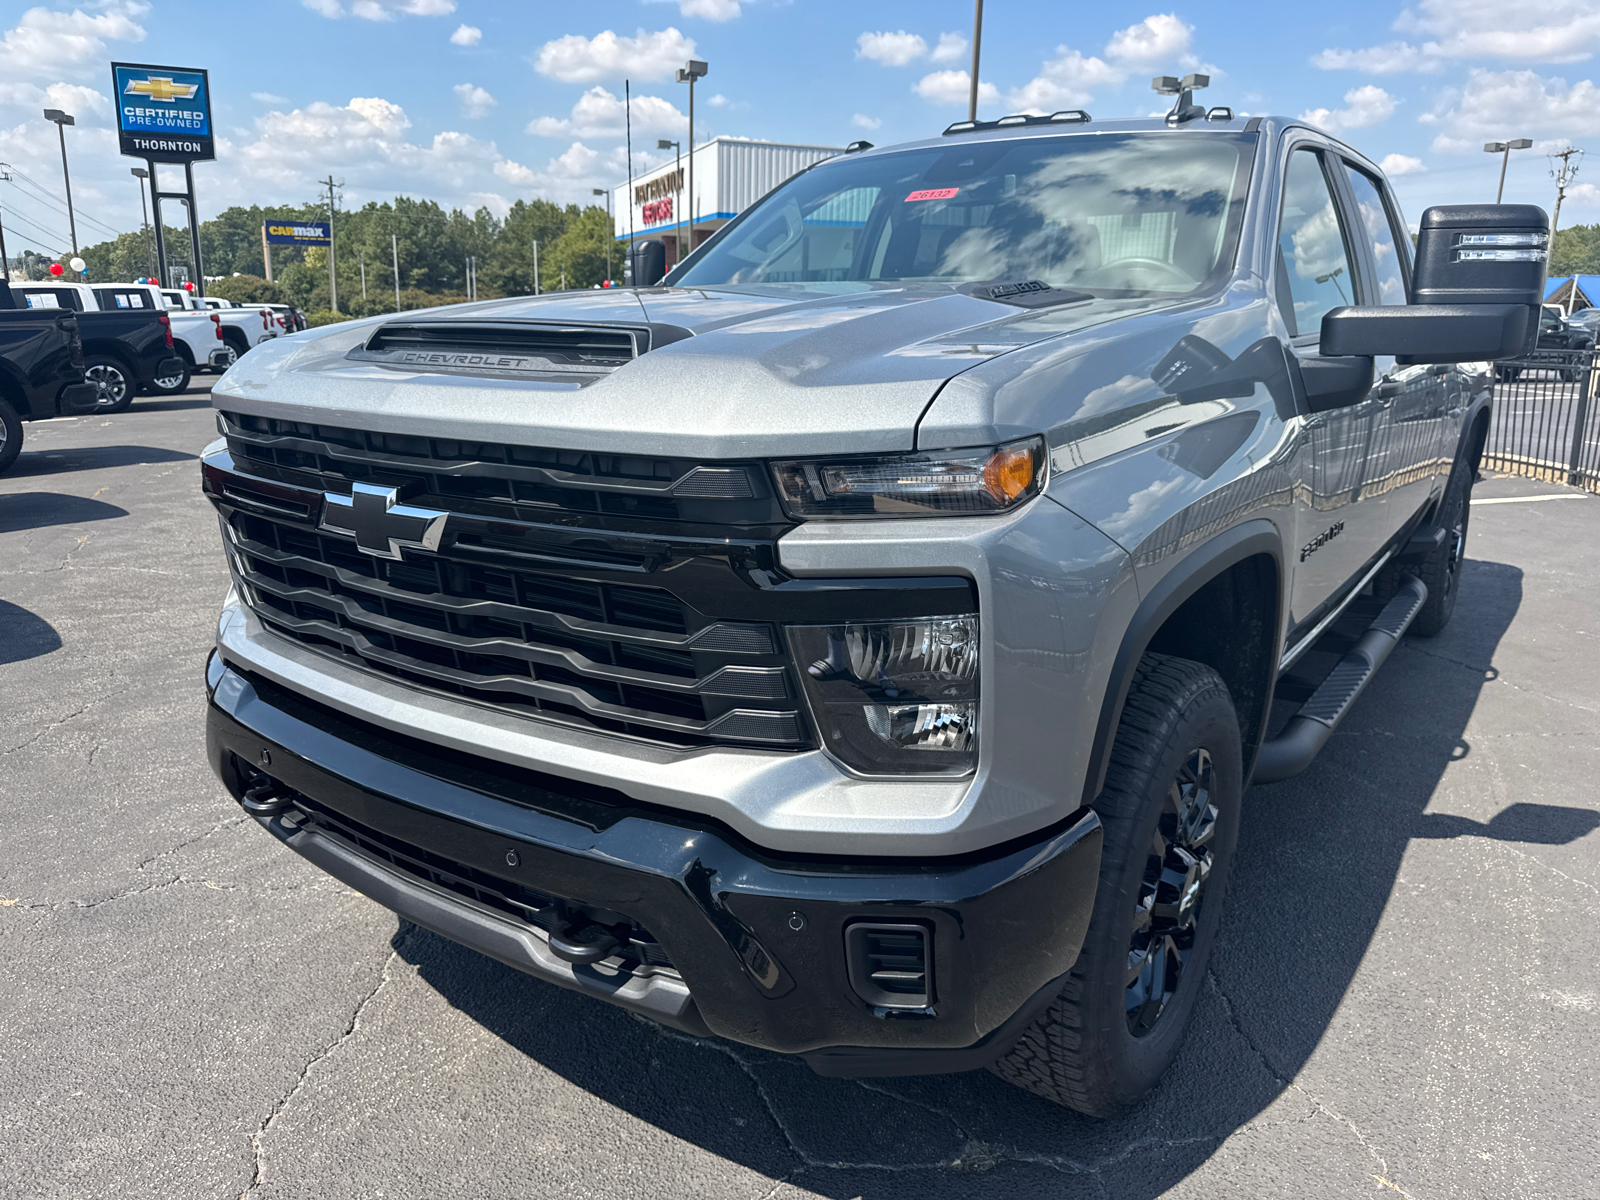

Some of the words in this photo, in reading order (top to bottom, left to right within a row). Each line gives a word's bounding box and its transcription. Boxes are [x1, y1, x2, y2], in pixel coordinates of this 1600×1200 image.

[124, 106, 204, 120] CERTIFIED
[129, 116, 201, 129] PRE-OWNED
[133, 139, 201, 152] THORNTON
[912, 190, 951, 199] 26132
[403, 352, 529, 368] CHEVROLET
